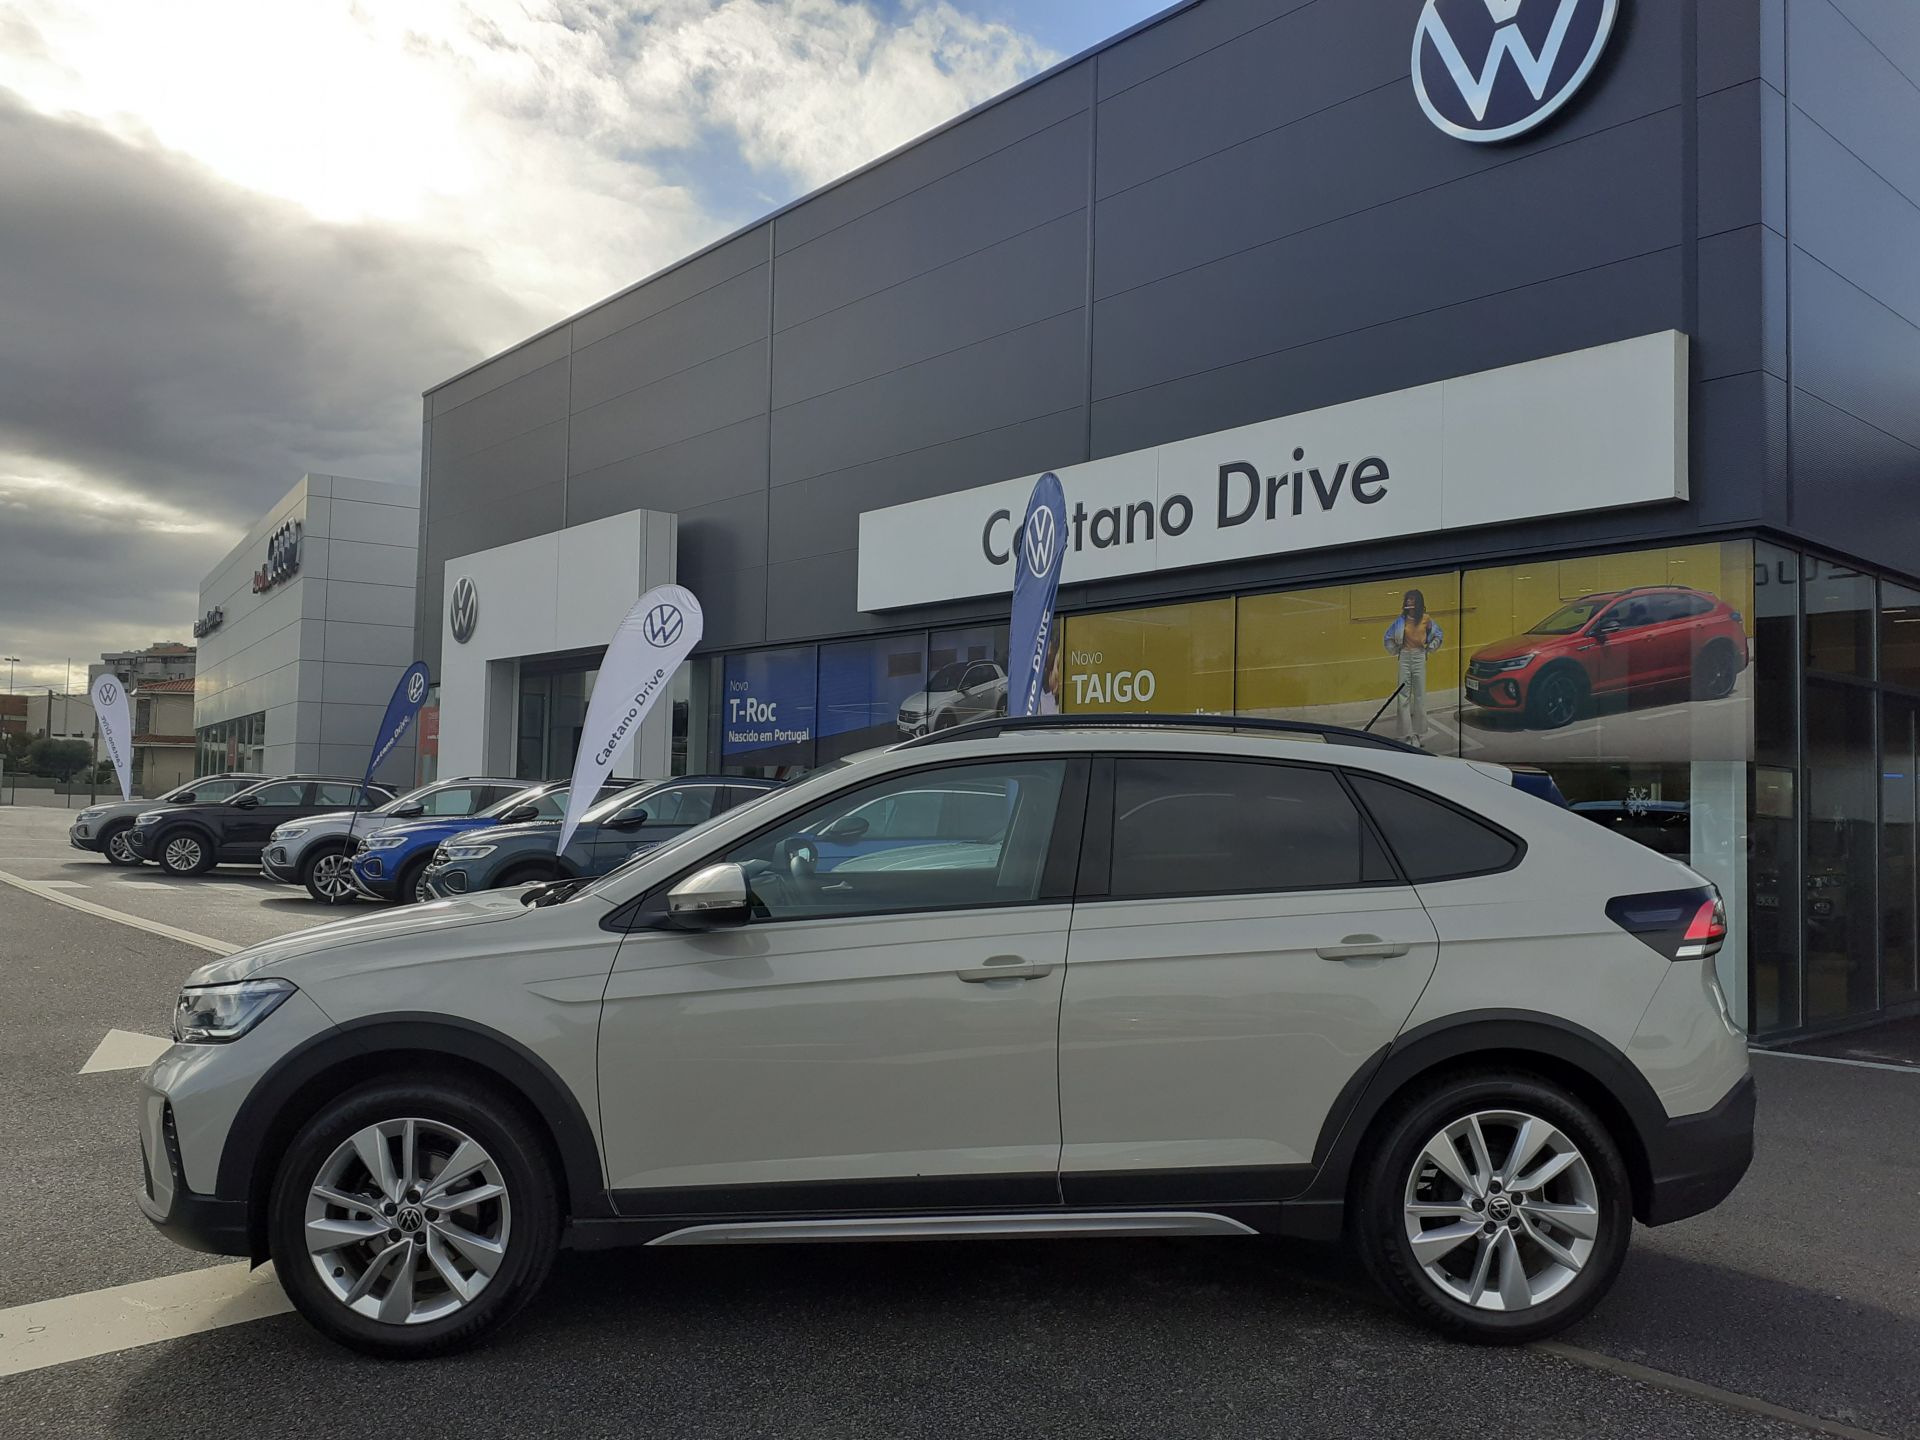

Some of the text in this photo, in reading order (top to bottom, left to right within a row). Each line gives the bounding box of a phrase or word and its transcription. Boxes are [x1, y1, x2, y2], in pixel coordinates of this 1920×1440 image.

[1411, 0, 1617, 142] W
[982, 446, 1390, 566] Ctano Drive
[1071, 650, 1103, 666] Novo
[729, 680, 749, 692] Novo
[1071, 669, 1156, 705] TAIGO
[595, 667, 665, 767] Caetano Drive
[729, 697, 777, 723] T-Roc
[728, 727, 810, 744] Nascido em Portugal
